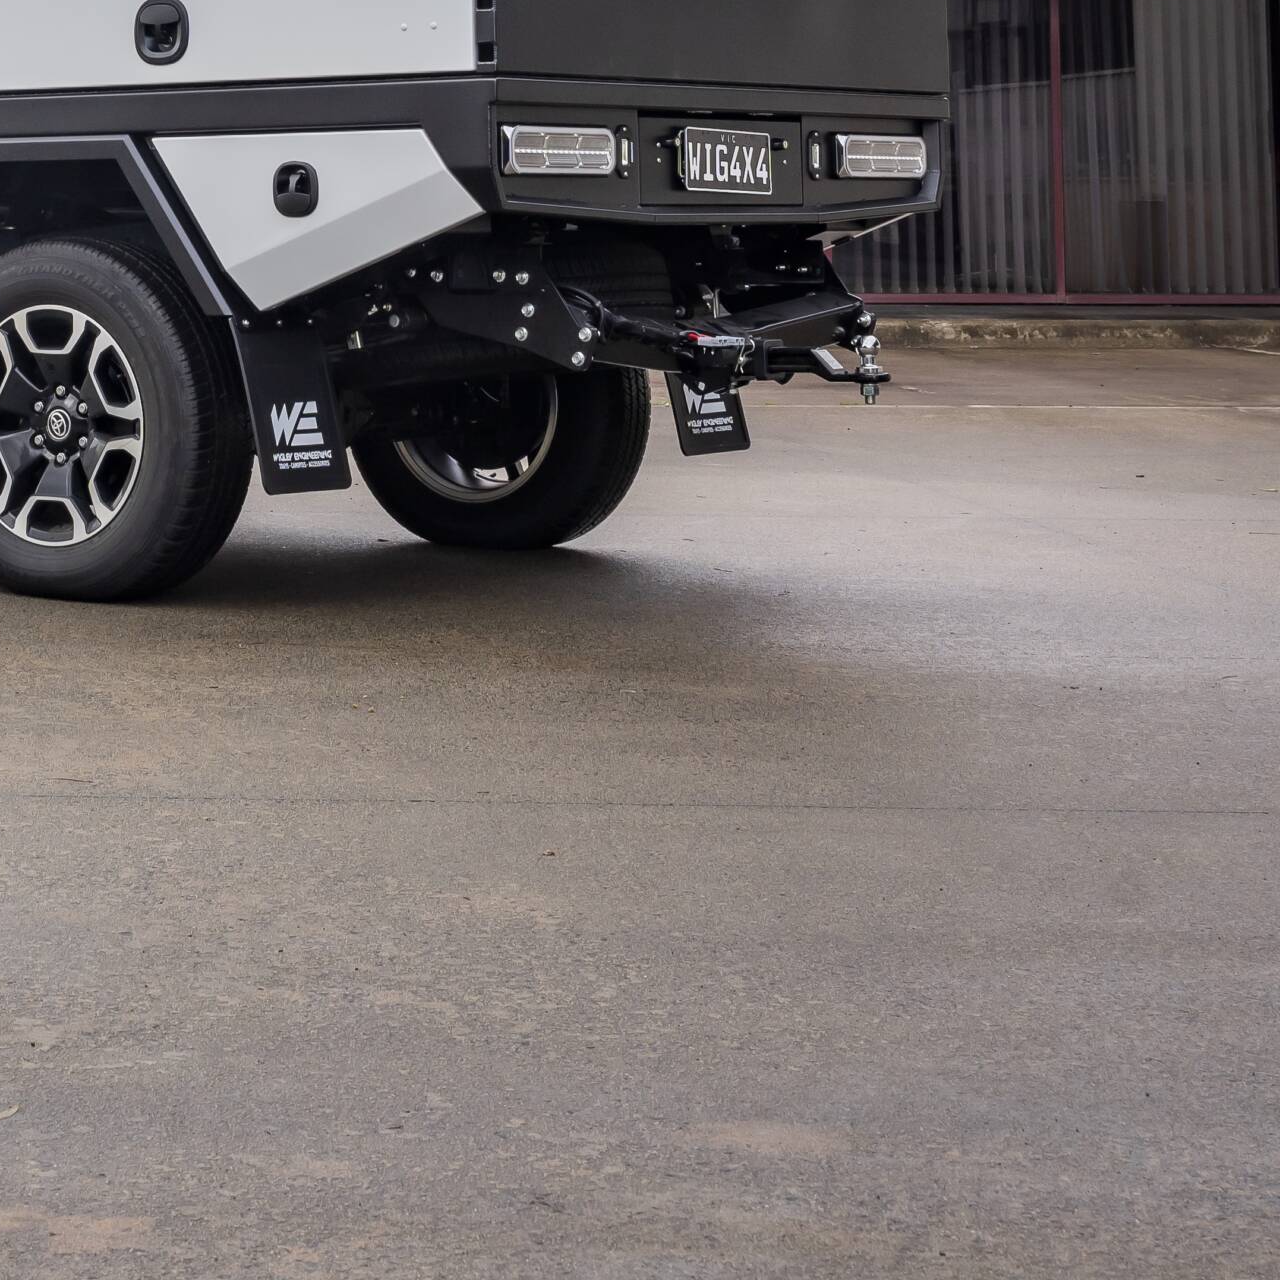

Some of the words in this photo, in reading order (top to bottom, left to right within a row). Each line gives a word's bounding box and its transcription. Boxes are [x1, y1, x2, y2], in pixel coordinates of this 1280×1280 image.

[720, 134, 736, 143] VIC
[688, 142, 769, 185] WIG4X4
[270, 401, 324, 447] WE
